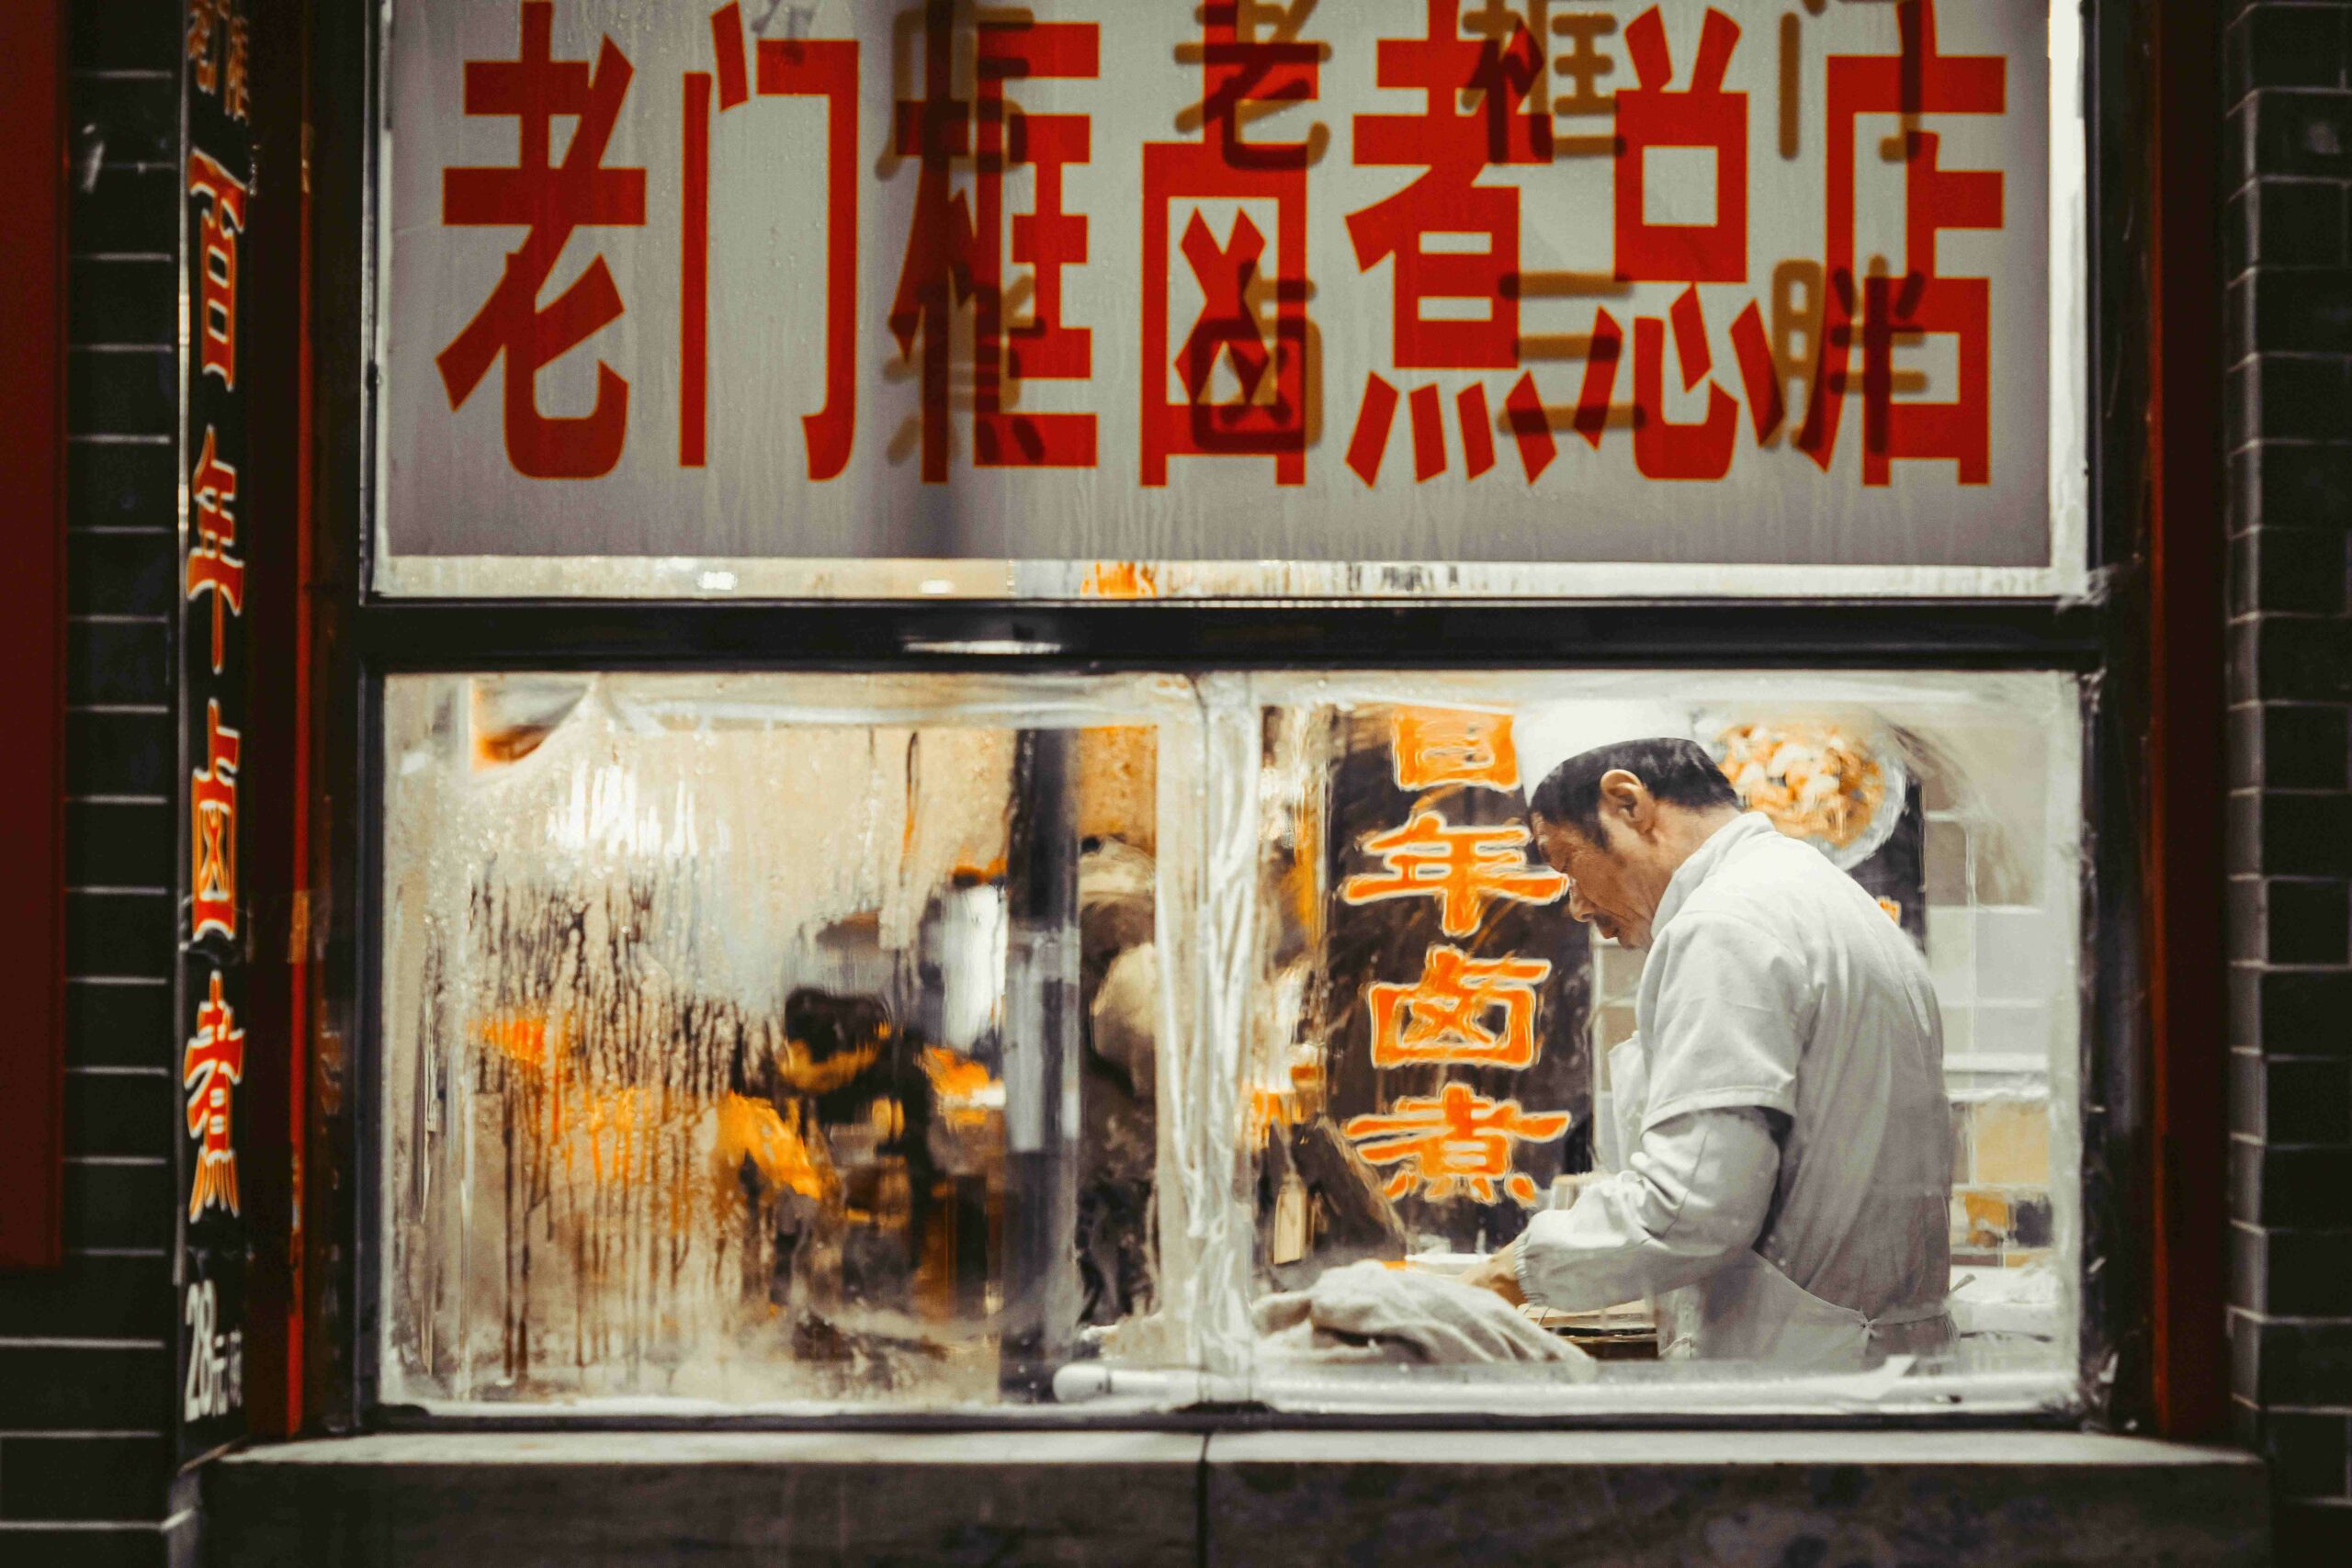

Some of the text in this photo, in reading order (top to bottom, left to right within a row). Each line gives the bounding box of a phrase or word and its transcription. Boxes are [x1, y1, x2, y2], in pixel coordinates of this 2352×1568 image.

[435, 0, 2007, 487] 老门框卤煮总店
[184, 146, 248, 1224] 百年卤煮
